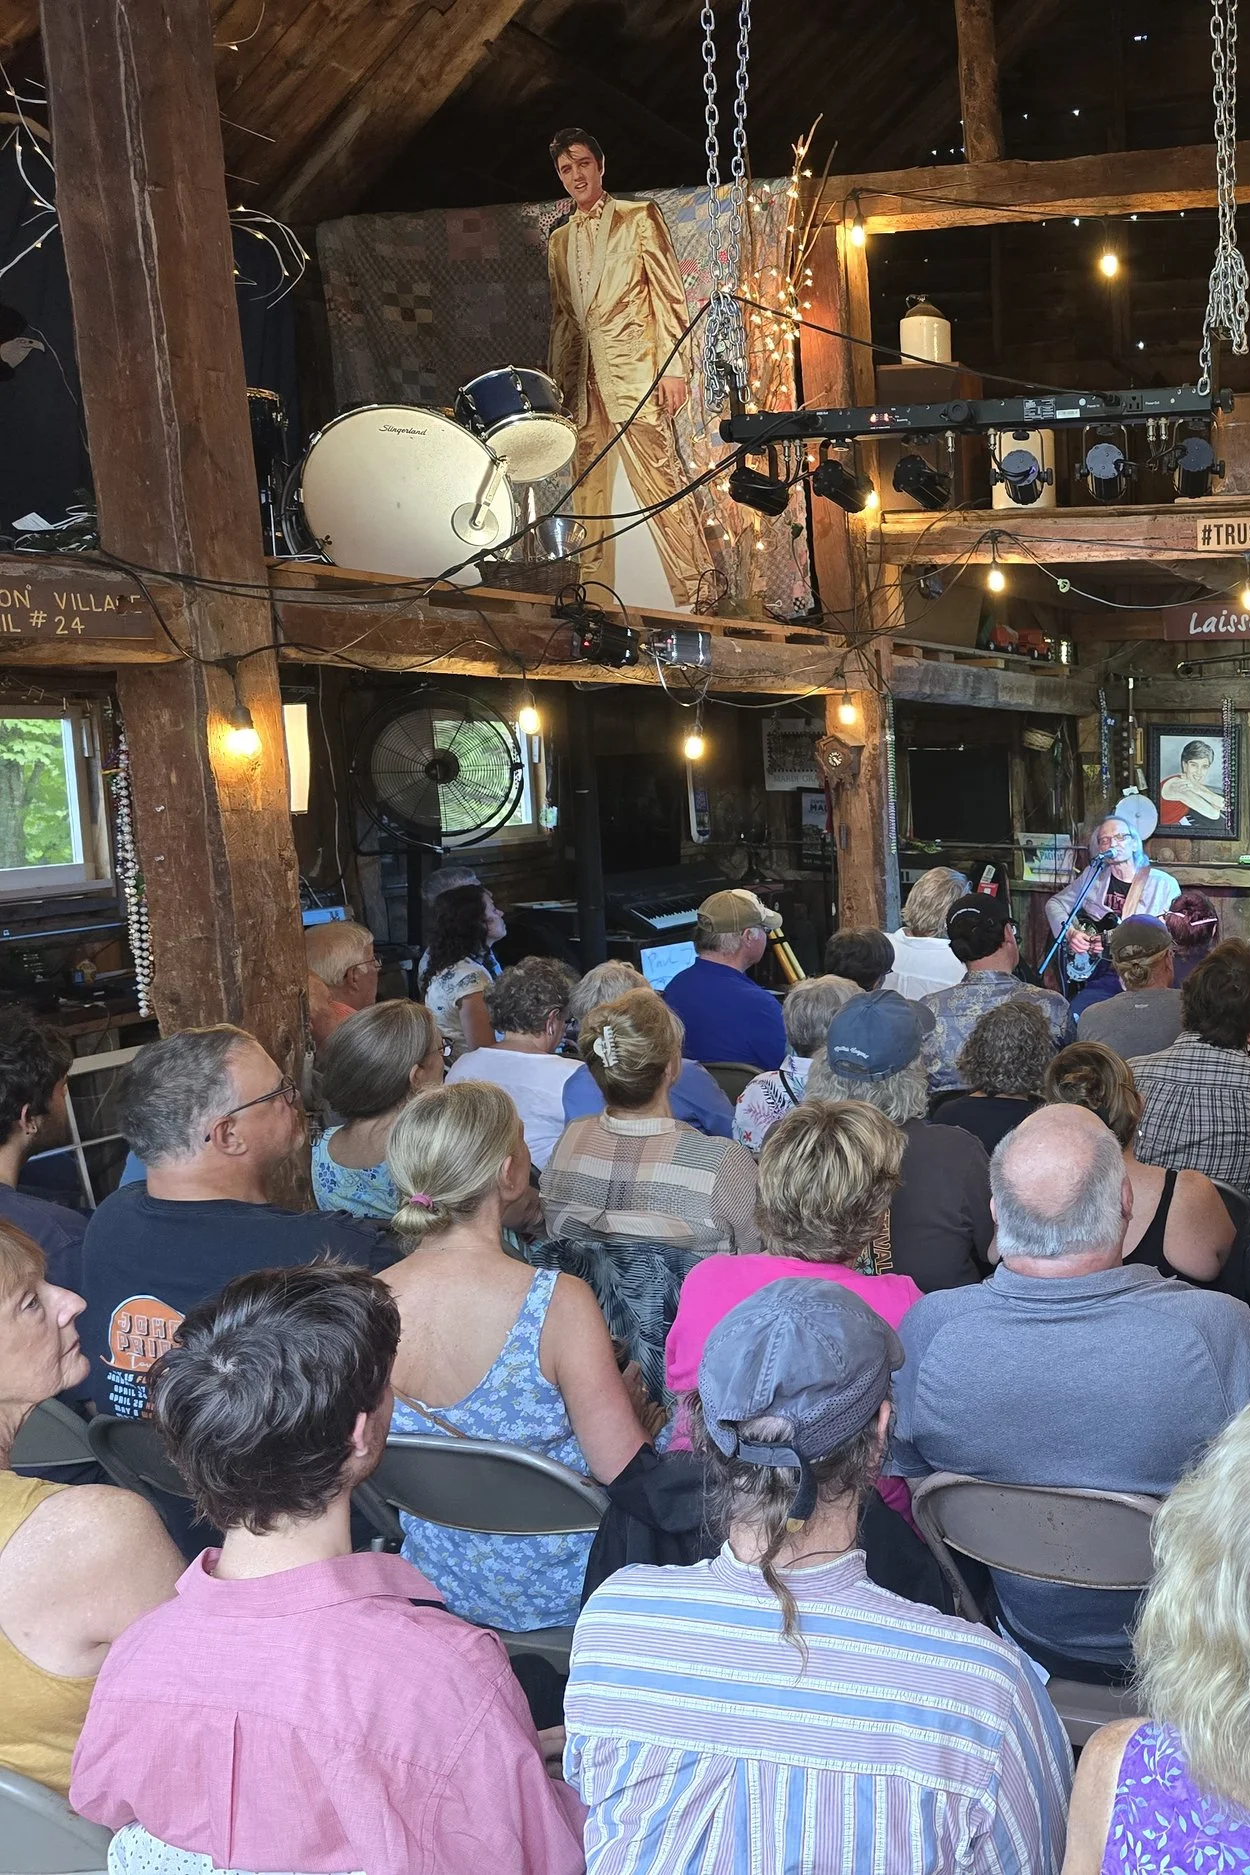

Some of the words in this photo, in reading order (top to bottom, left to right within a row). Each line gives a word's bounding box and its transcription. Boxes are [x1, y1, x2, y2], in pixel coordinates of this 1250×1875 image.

[379, 424, 427, 435] Slingerland
[55, 616, 85, 634] 24
[109, 1392, 131, 1406] APRIL
